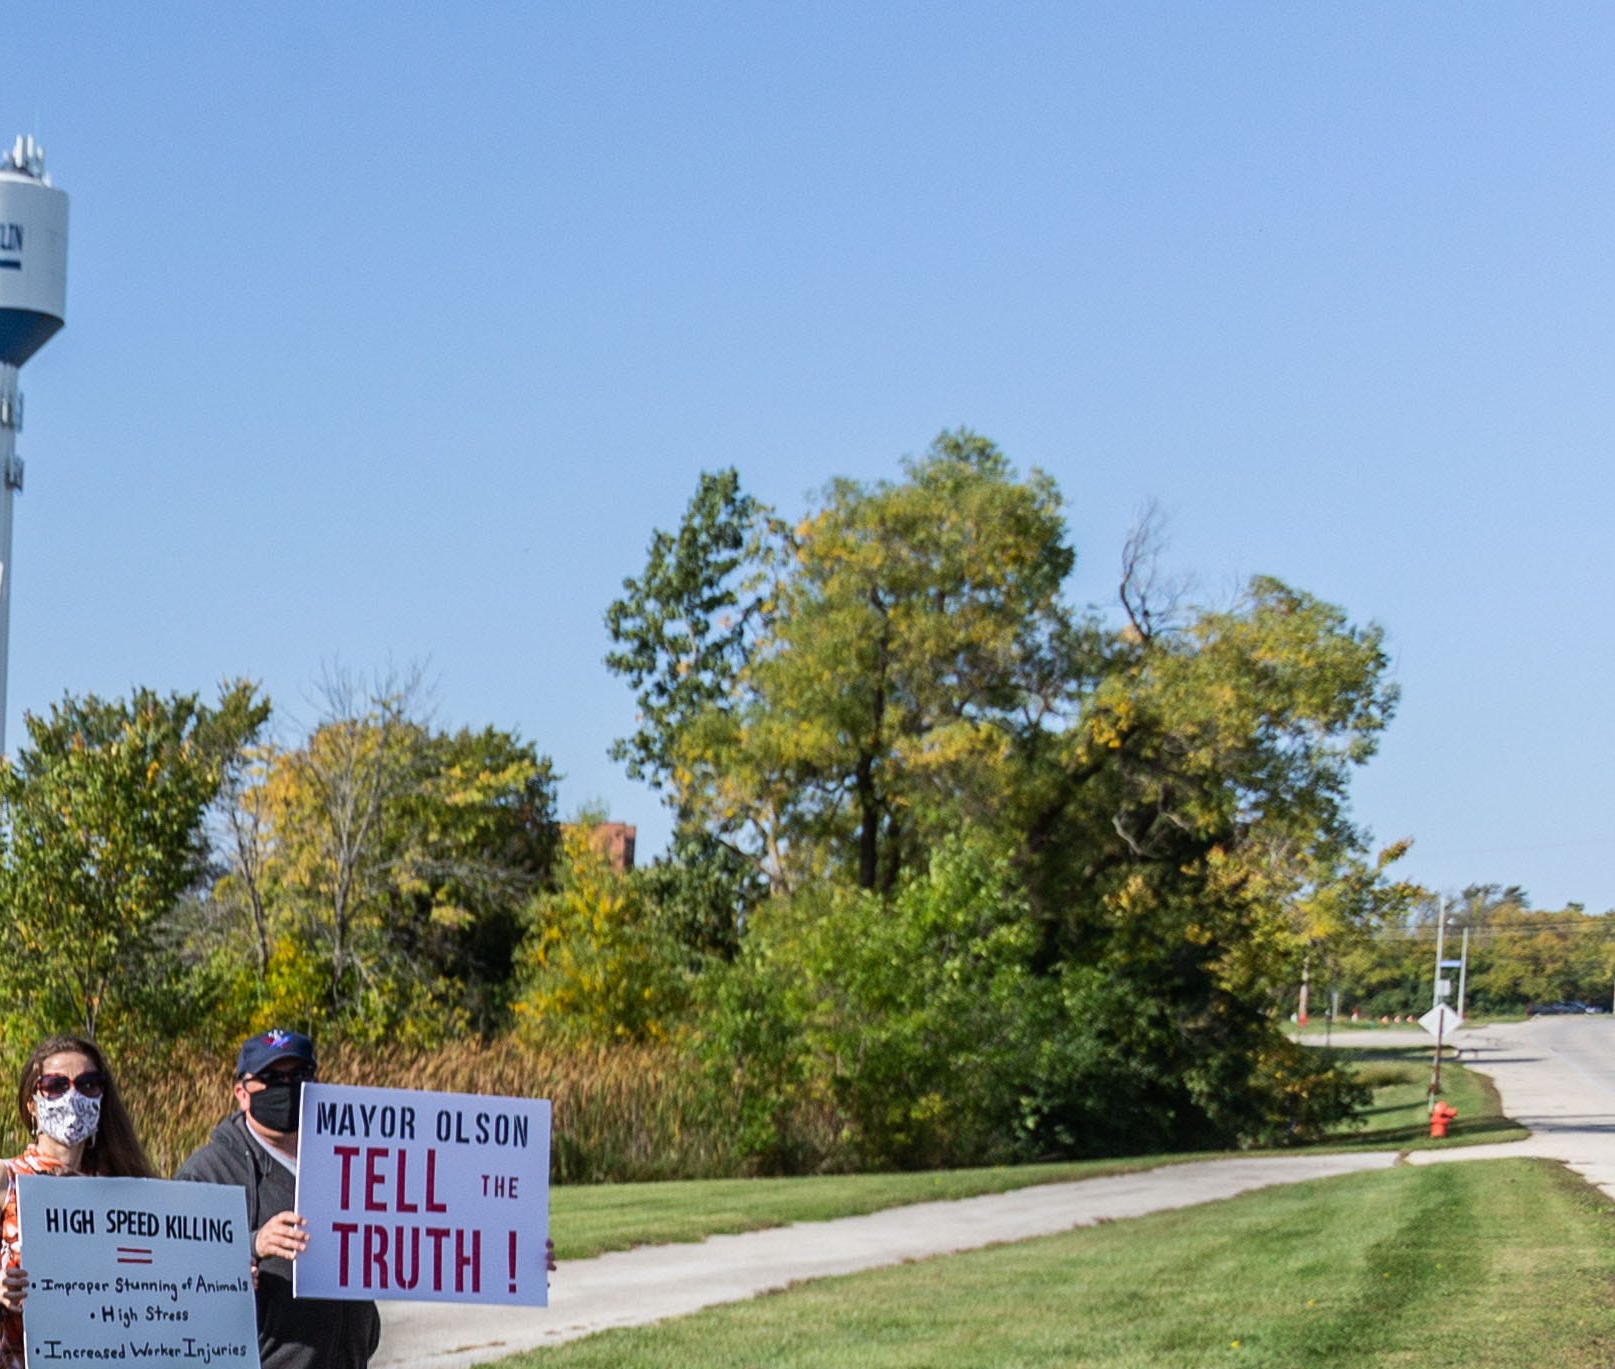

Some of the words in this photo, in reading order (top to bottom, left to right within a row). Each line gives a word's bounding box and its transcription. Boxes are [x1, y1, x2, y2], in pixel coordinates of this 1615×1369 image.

[316, 1102, 415, 1140] MAYOR
[436, 1110, 528, 1148] OLSON
[334, 1146, 447, 1213] TELL
[481, 1175, 519, 1199] THE
[46, 1208, 94, 1234] HIGH
[106, 1209, 159, 1237] SPEED
[166, 1215, 233, 1243] KILLING
[332, 1223, 481, 1293] TRUTH
[41, 1279, 109, 1296] Improper
[115, 1277, 178, 1302] Stunning
[181, 1277, 192, 1290] of
[195, 1275, 248, 1293] Animals
[102, 1305, 138, 1328] High
[145, 1306, 189, 1321] Stress
[44, 1340, 125, 1360] Increased
[130, 1341, 181, 1358] Worker
[182, 1338, 247, 1364] Injuries
